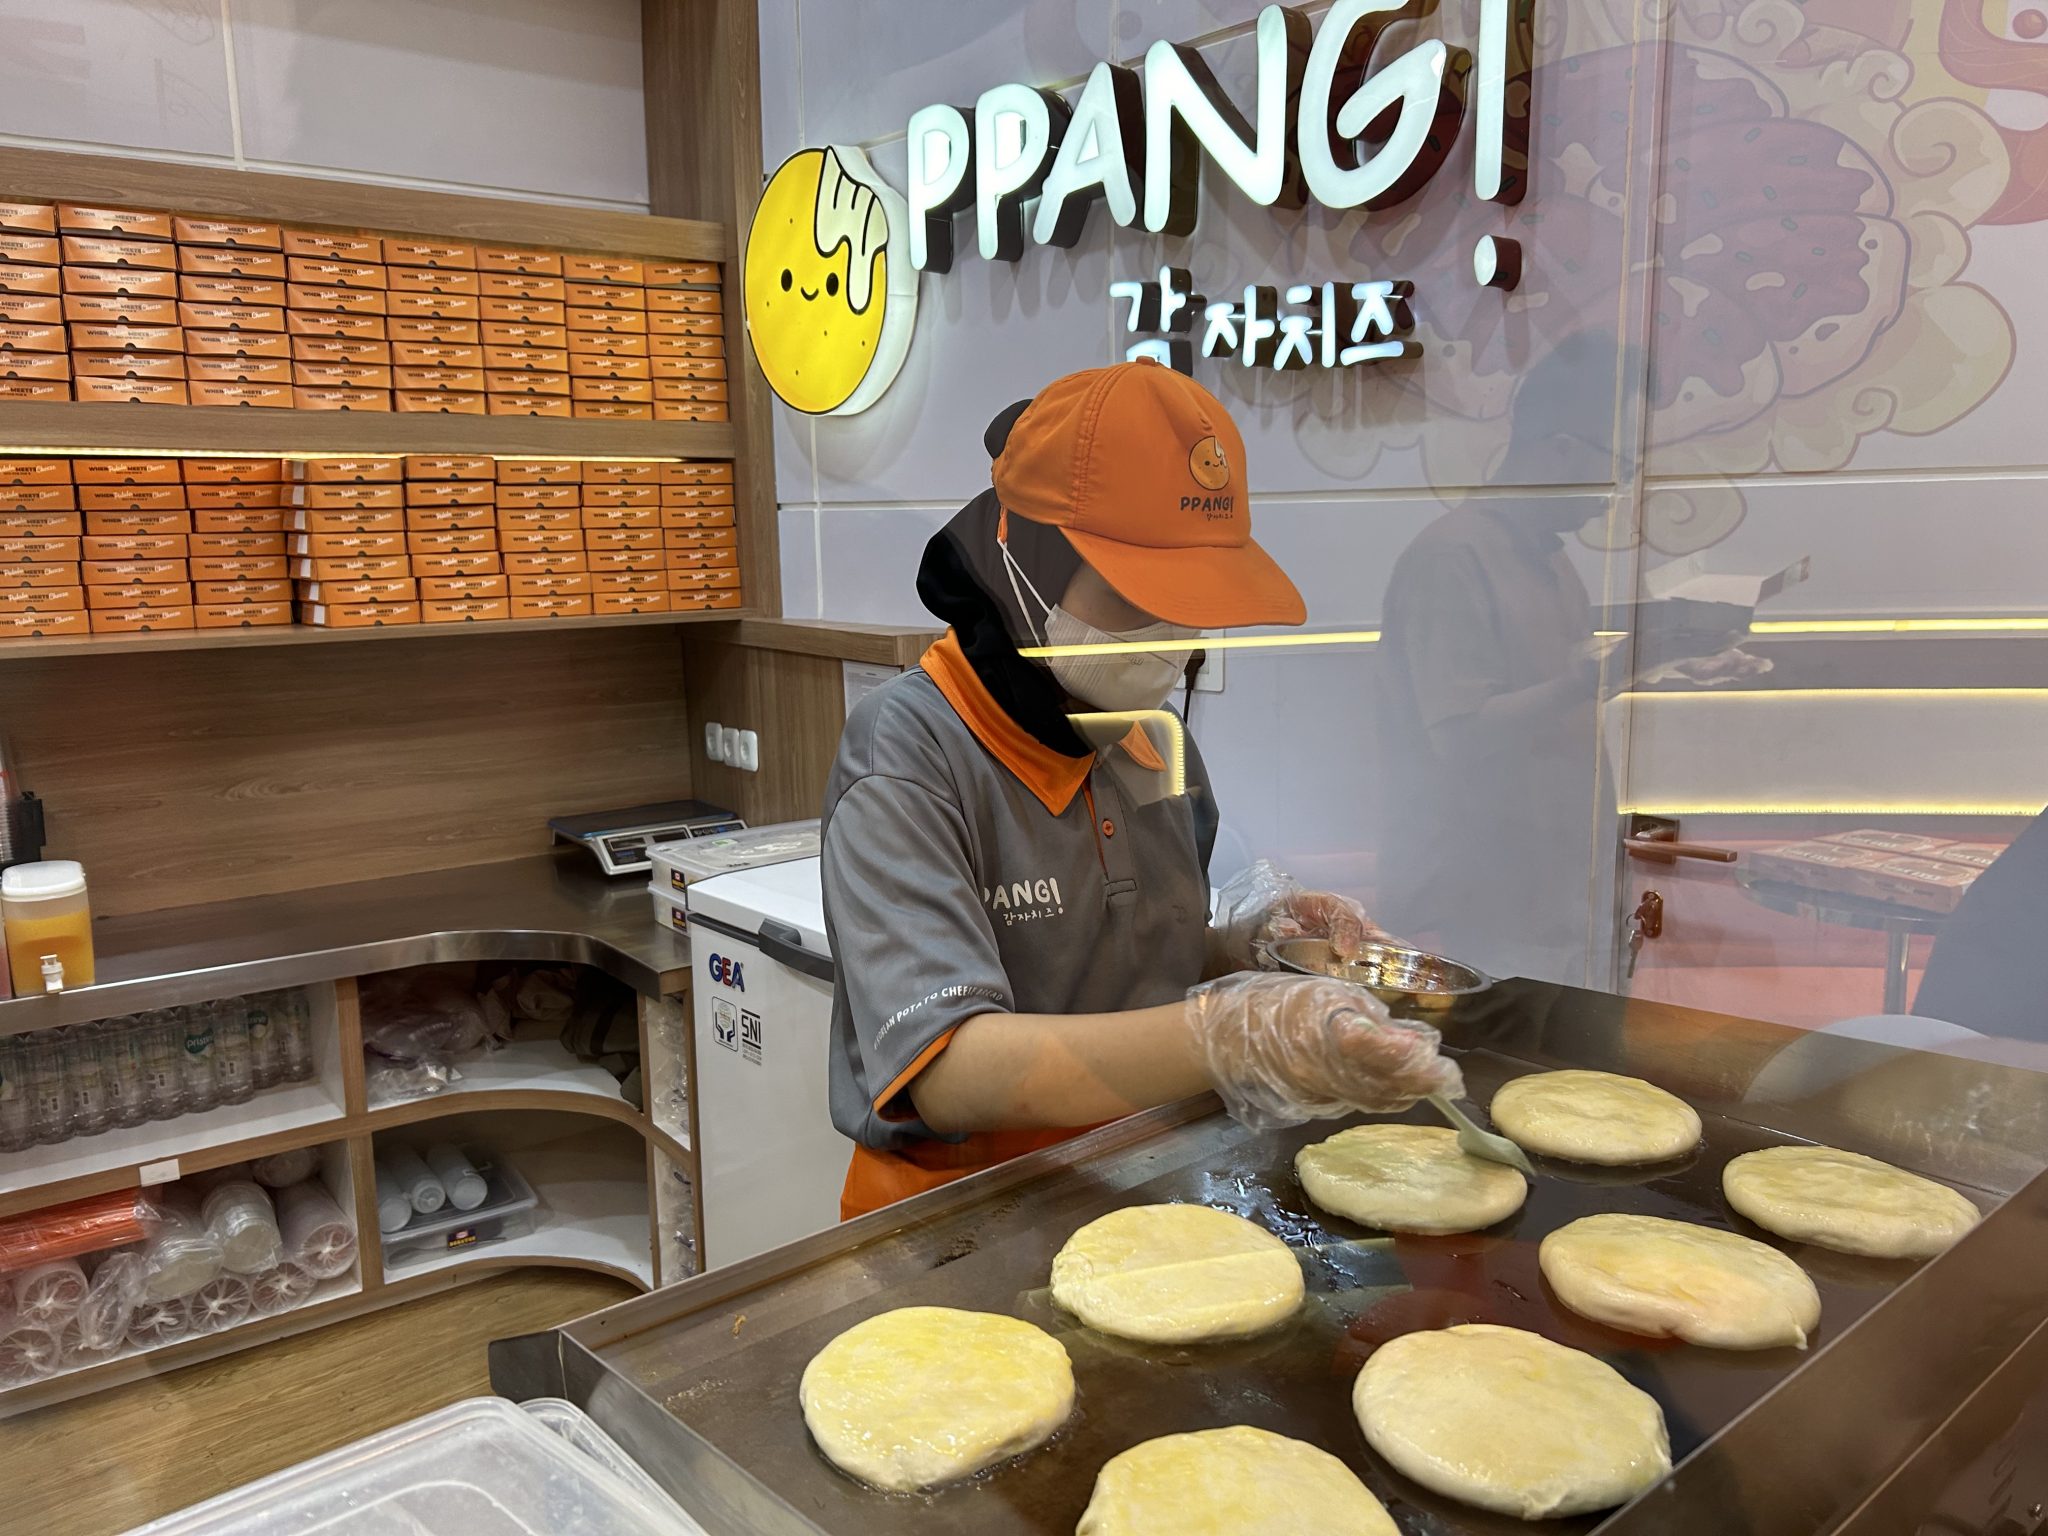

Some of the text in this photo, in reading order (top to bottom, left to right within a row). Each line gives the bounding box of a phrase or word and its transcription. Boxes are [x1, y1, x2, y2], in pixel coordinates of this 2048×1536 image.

[907, 0, 1510, 287] PPANG!
[1110, 265, 1405, 370] 감자치즈
[1180, 496, 1234, 518] PPANG!
[1003, 907, 1055, 926] 감자치즈
[709, 953, 745, 992] GEA
[896, 992, 938, 1022] POTATO
[741, 1014, 762, 1044] SNI
